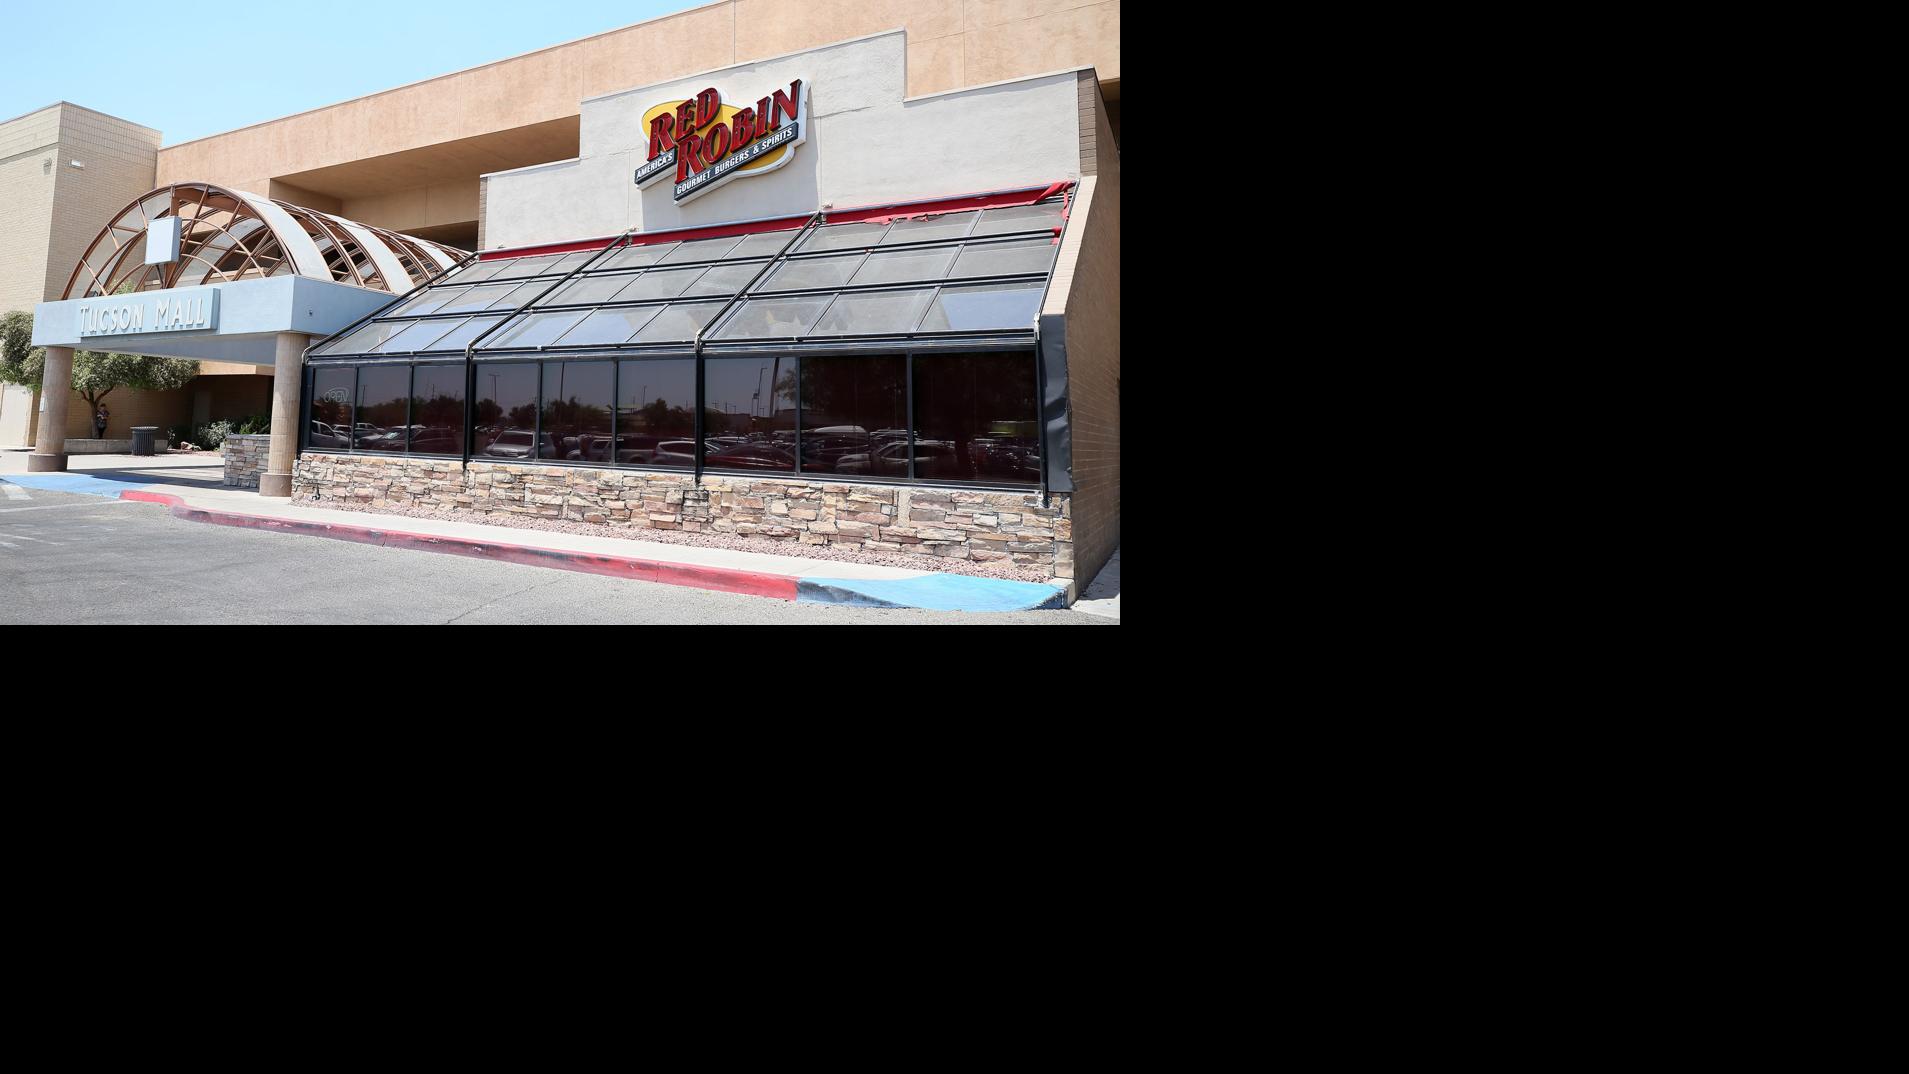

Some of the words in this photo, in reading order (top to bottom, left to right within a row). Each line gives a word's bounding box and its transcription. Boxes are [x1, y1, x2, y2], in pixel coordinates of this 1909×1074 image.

[647, 87, 721, 161] RED
[675, 79, 802, 184] ROBIN
[636, 152, 673, 179] AMERICA'S
[676, 172, 711, 195] GOURMET
[714, 151, 750, 175] BURGERS
[752, 144, 760, 154] &
[761, 129, 793, 150] SPIRITS
[80, 303, 145, 335] TUCSON
[154, 297, 205, 330] MALL
